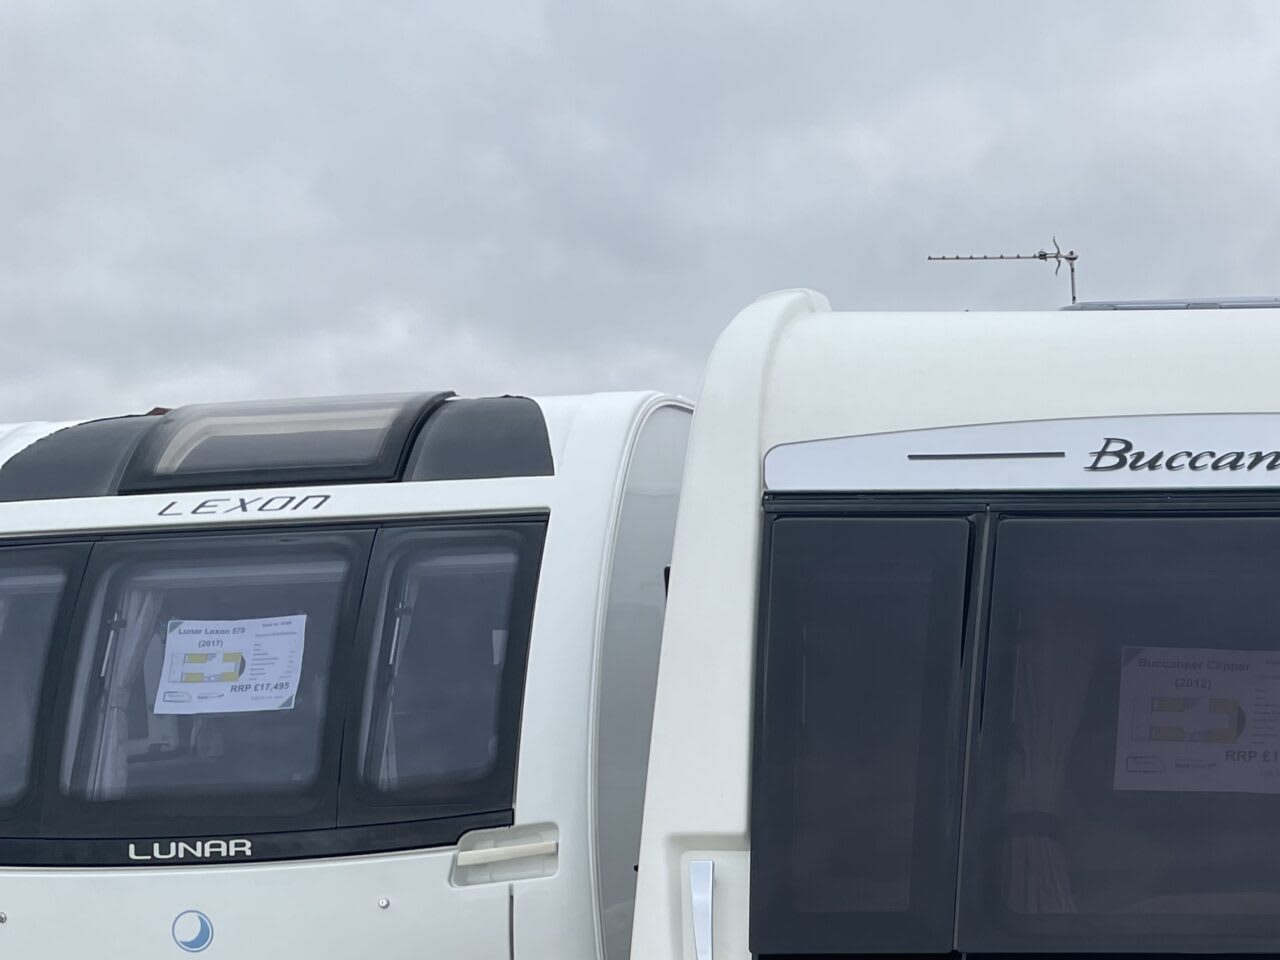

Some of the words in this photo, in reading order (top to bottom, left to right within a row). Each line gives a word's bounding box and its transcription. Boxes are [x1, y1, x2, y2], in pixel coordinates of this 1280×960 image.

[157, 494, 332, 516] LEXON
[198, 639, 223, 649] (2017)
[230, 683, 251, 693] RRP
[253, 681, 290, 692] £17,495
[1224, 750, 1258, 763] RRP
[128, 838, 252, 860] LUNAR
